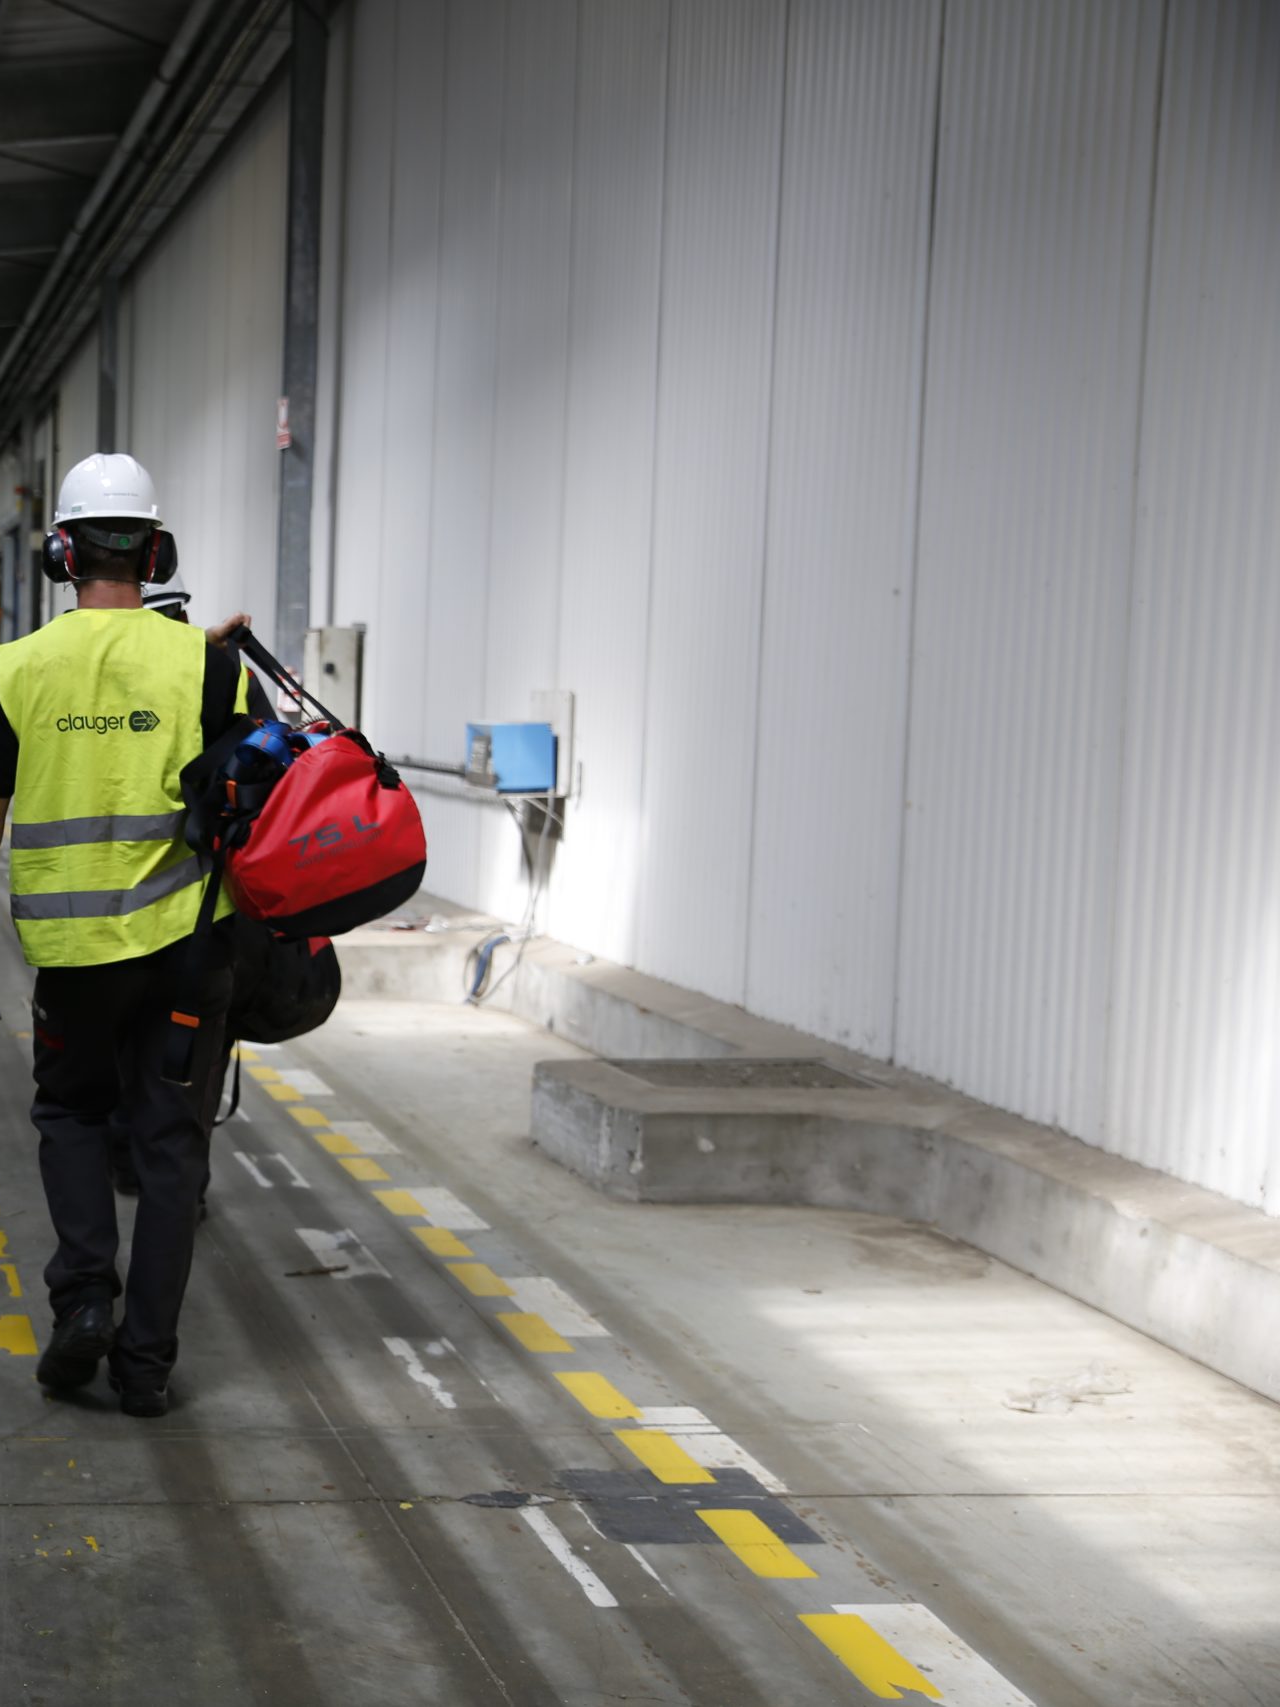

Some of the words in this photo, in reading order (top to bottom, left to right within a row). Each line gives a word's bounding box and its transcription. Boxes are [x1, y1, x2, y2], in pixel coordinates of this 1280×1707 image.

[56, 713, 125, 735] clauger
[288, 822, 344, 856] 75
[352, 815, 380, 832] L
